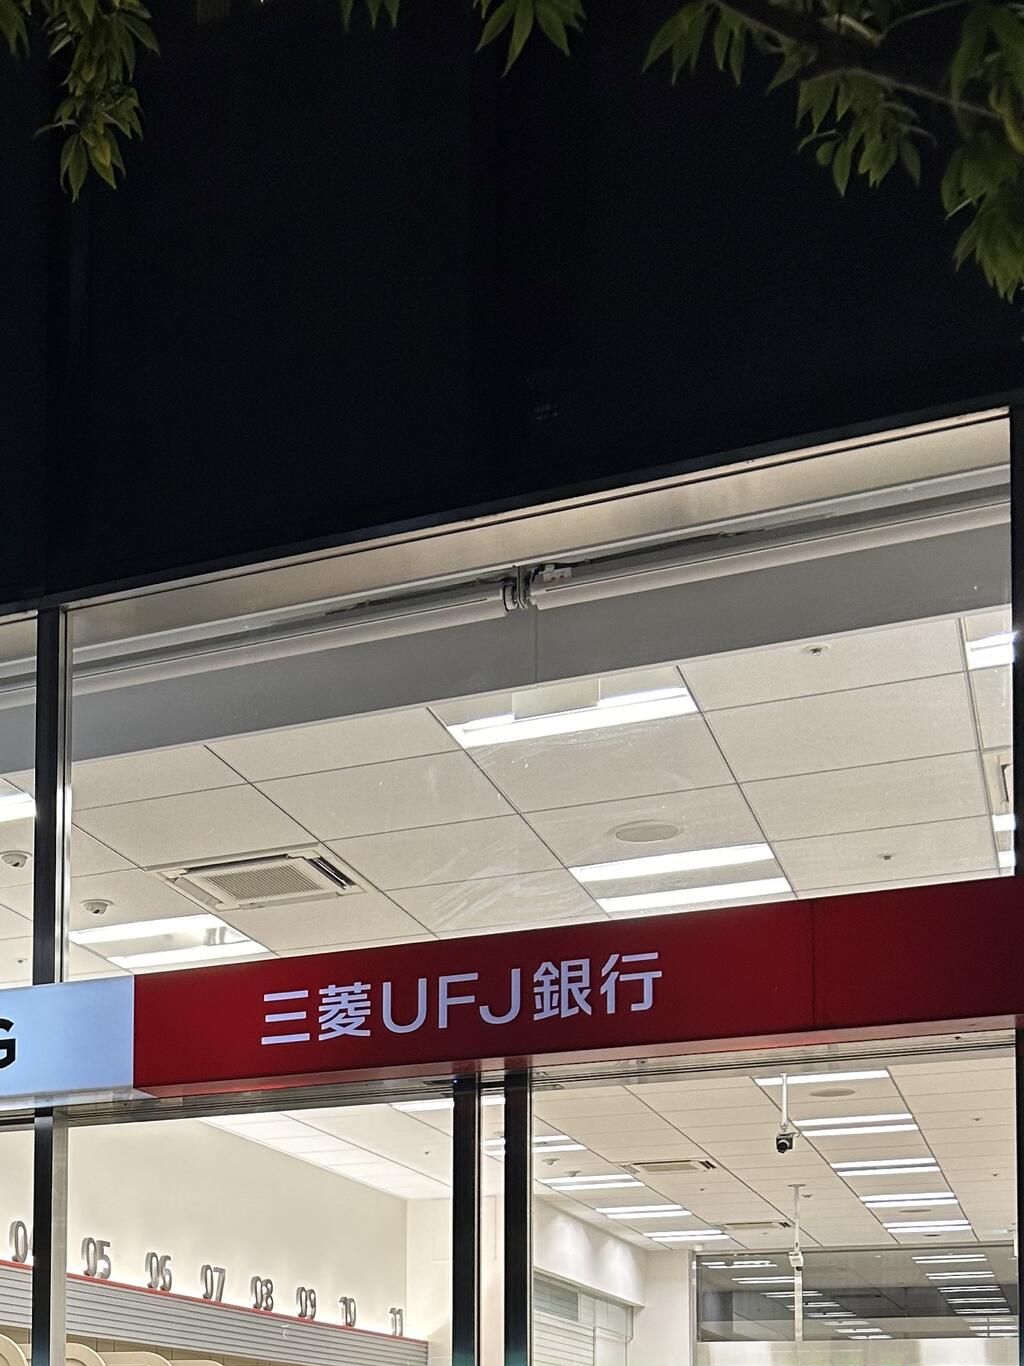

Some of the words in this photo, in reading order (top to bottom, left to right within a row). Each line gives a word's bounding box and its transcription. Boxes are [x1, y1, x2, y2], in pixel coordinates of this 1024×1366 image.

[261, 951, 663, 1045] 三菱UFJ銀行
[9, 1220, 33, 1263] 0
[81, 1237, 111, 1279] 05
[145, 1252, 172, 1291] 06
[200, 1264, 226, 1302] 07
[251, 1276, 274, 1311] 08
[296, 1287, 316, 1320] 09
[339, 1296, 357, 1328] 10
[389, 1307, 404, 1336] 11
